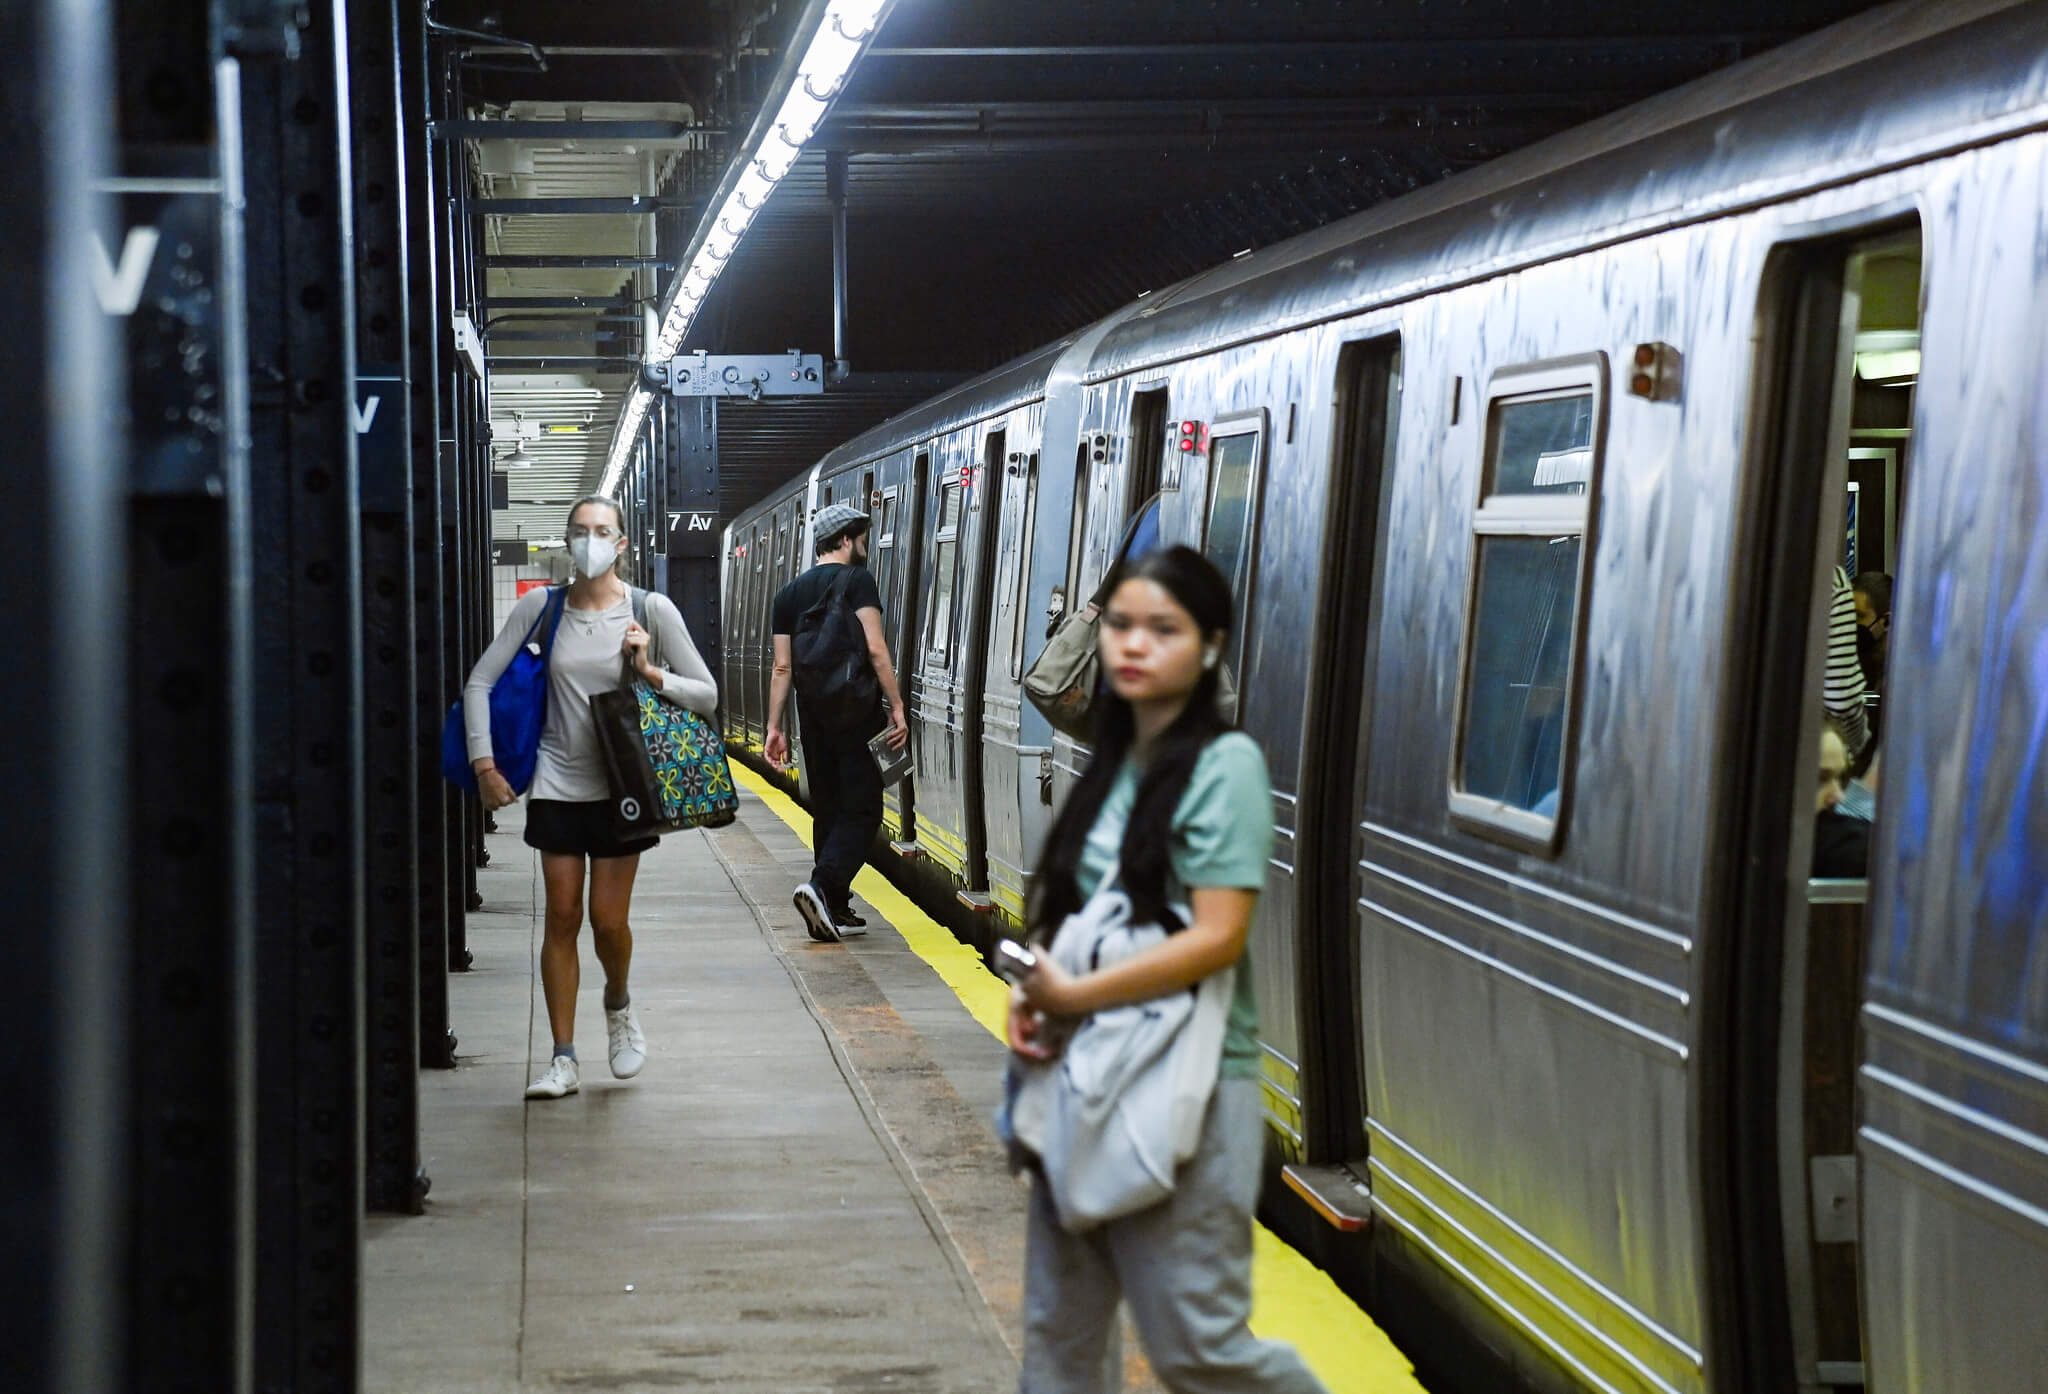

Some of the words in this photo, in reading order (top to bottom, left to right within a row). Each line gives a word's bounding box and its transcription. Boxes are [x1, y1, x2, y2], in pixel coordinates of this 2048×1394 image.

[90, 225, 160, 316] v
[352, 395, 380, 434] v
[668, 514, 680, 531] 7
[687, 513, 713, 531] Av
